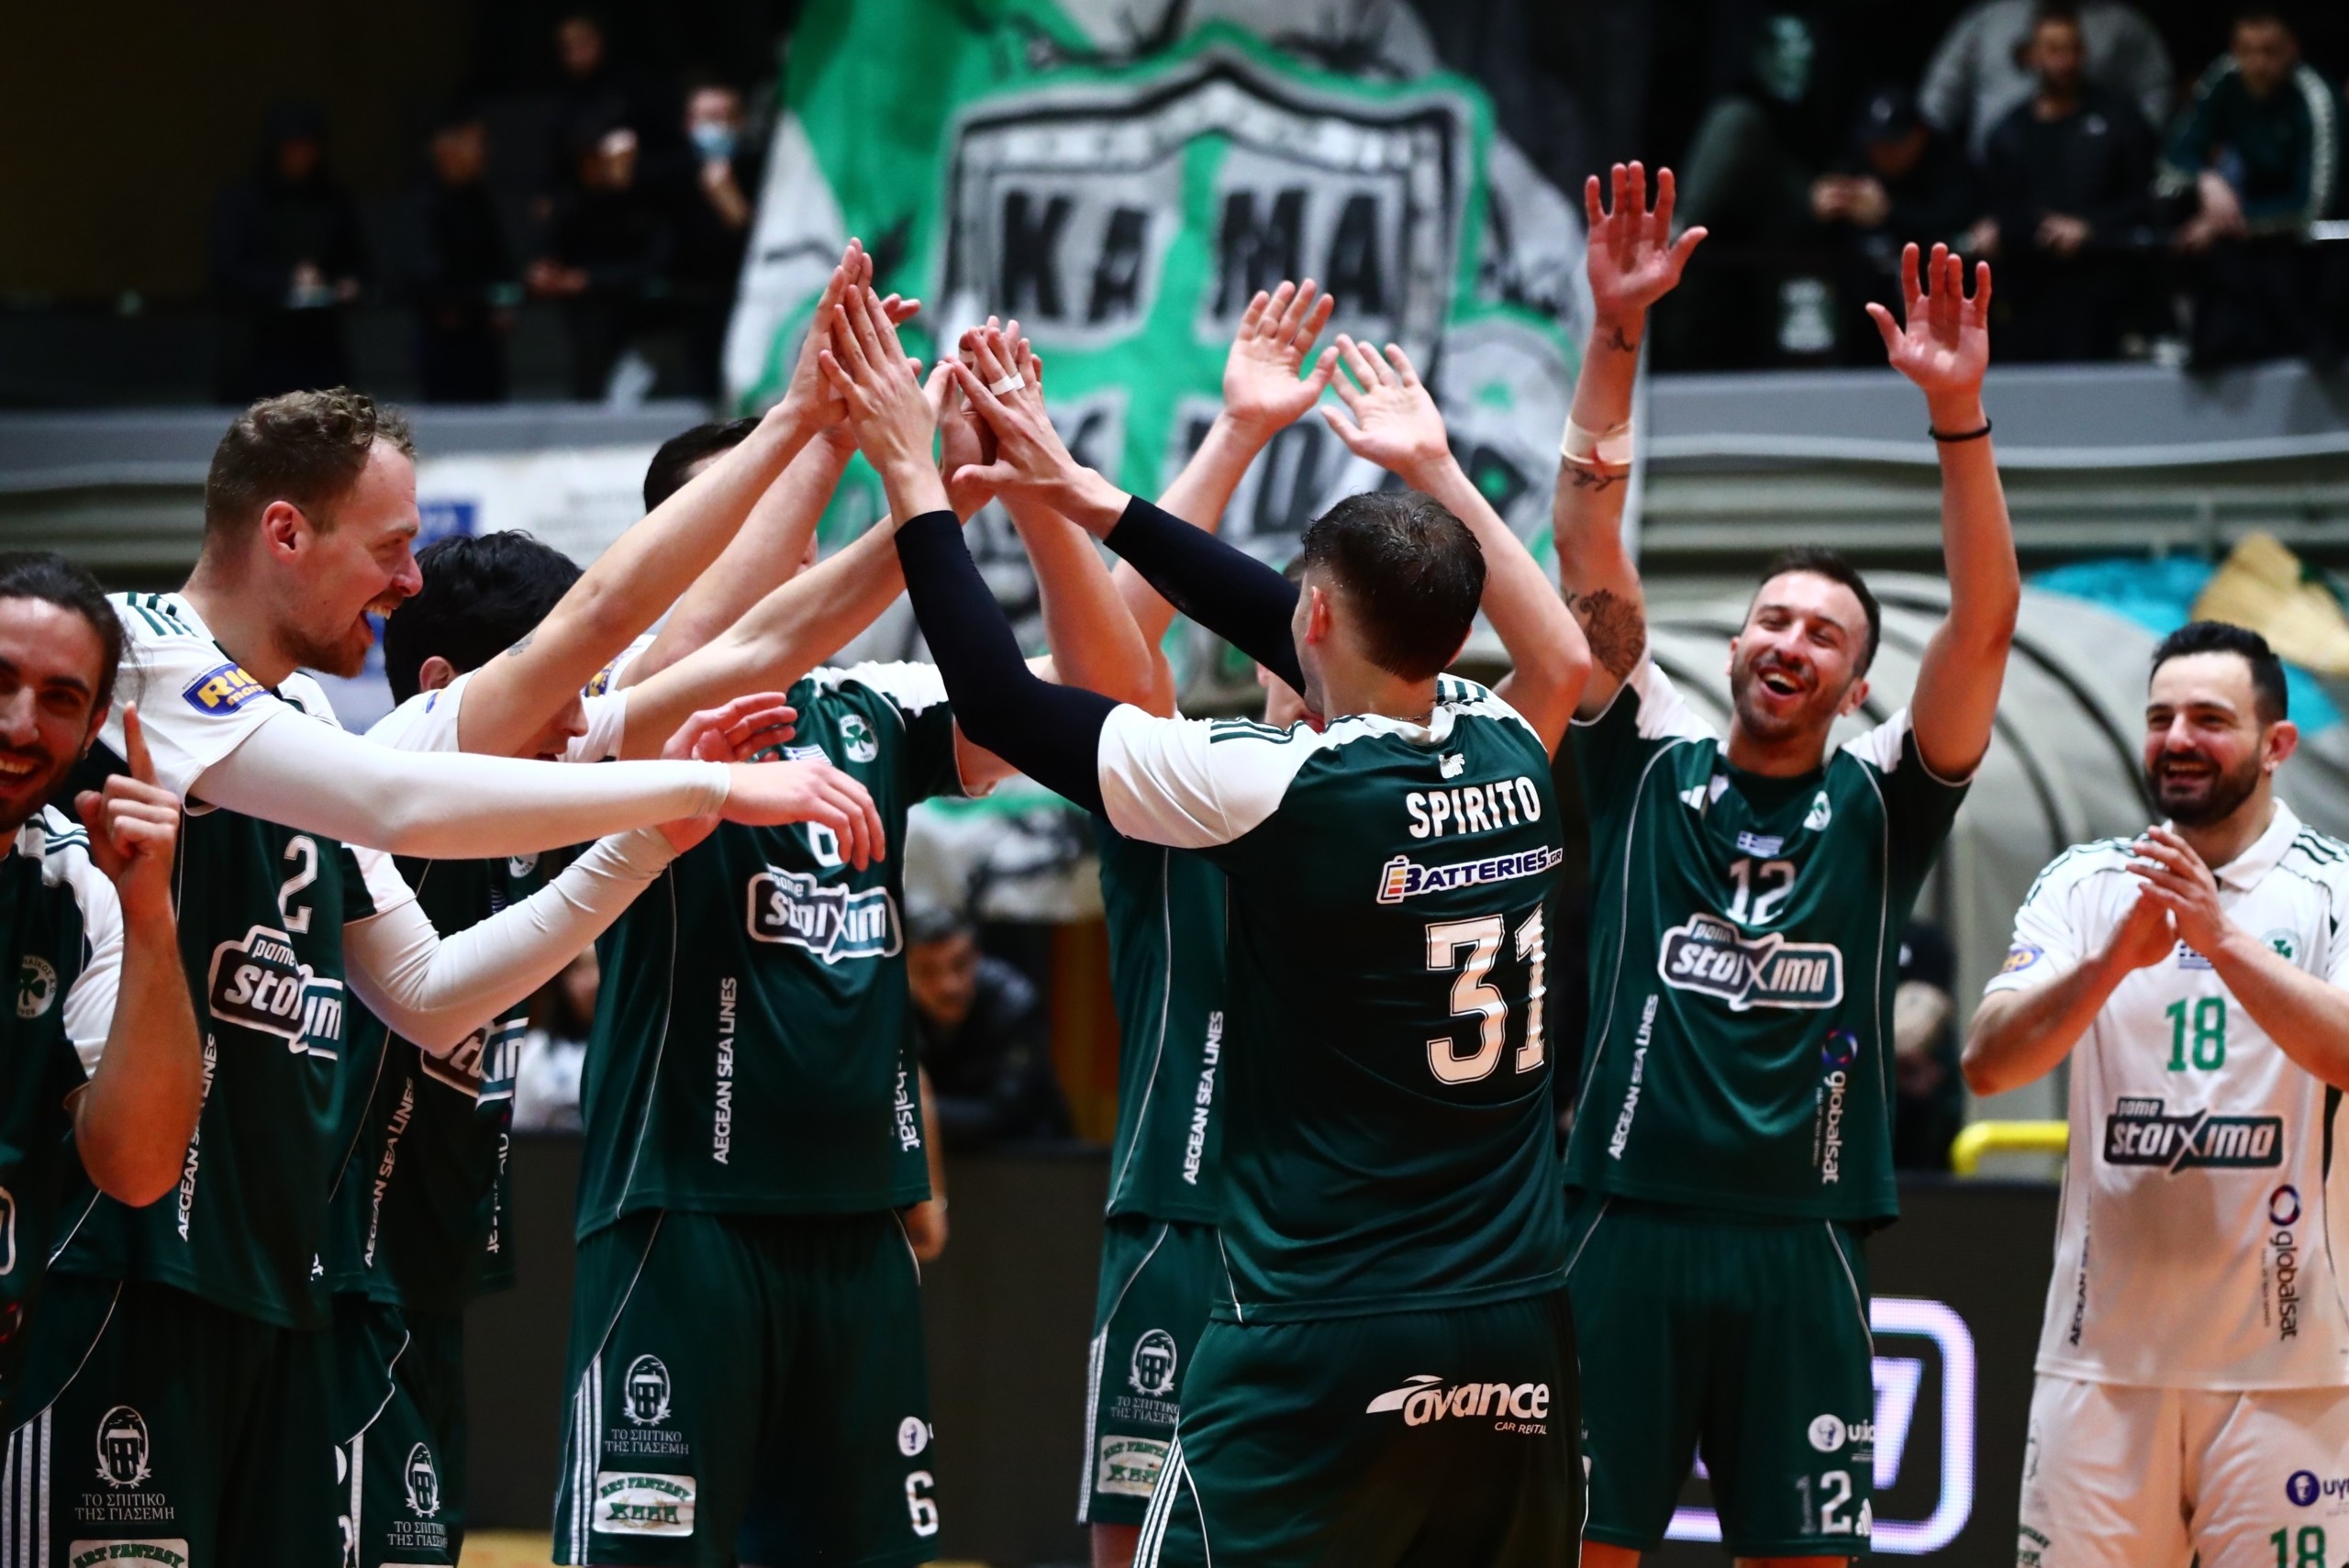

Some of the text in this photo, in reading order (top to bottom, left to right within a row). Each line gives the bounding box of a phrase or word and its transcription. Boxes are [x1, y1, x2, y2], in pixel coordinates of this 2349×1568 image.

[1406, 776, 1542, 840] SPIRITO
[278, 835, 318, 934] 2
[1726, 858, 1796, 926] 12
[1425, 903, 1546, 1084] 31
[713, 977, 738, 1165] AEGEAN SEA LINES
[2165, 996, 2227, 1072] 18
[1183, 1011, 1224, 1186] AEGEAN SEA LINES
[1609, 994, 1659, 1160] AEGEAN SEA LINES
[1821, 1071, 1847, 1184] globalsat
[177, 1148, 200, 1243] AEGEAN
[364, 1180, 387, 1269] AEGEAN
[379, 1138, 399, 1179] SEA
[2270, 1230, 2300, 1342] globalsat
[1403, 1382, 1551, 1428] avance
[1495, 1421, 1516, 1431] CAR
[75, 1507, 106, 1520] ΤΗΣ
[82, 1494, 103, 1506] ΤΟ
[905, 1470, 940, 1537] 6
[1796, 1470, 1854, 1534] 12
[2270, 1526, 2327, 1568] 18
